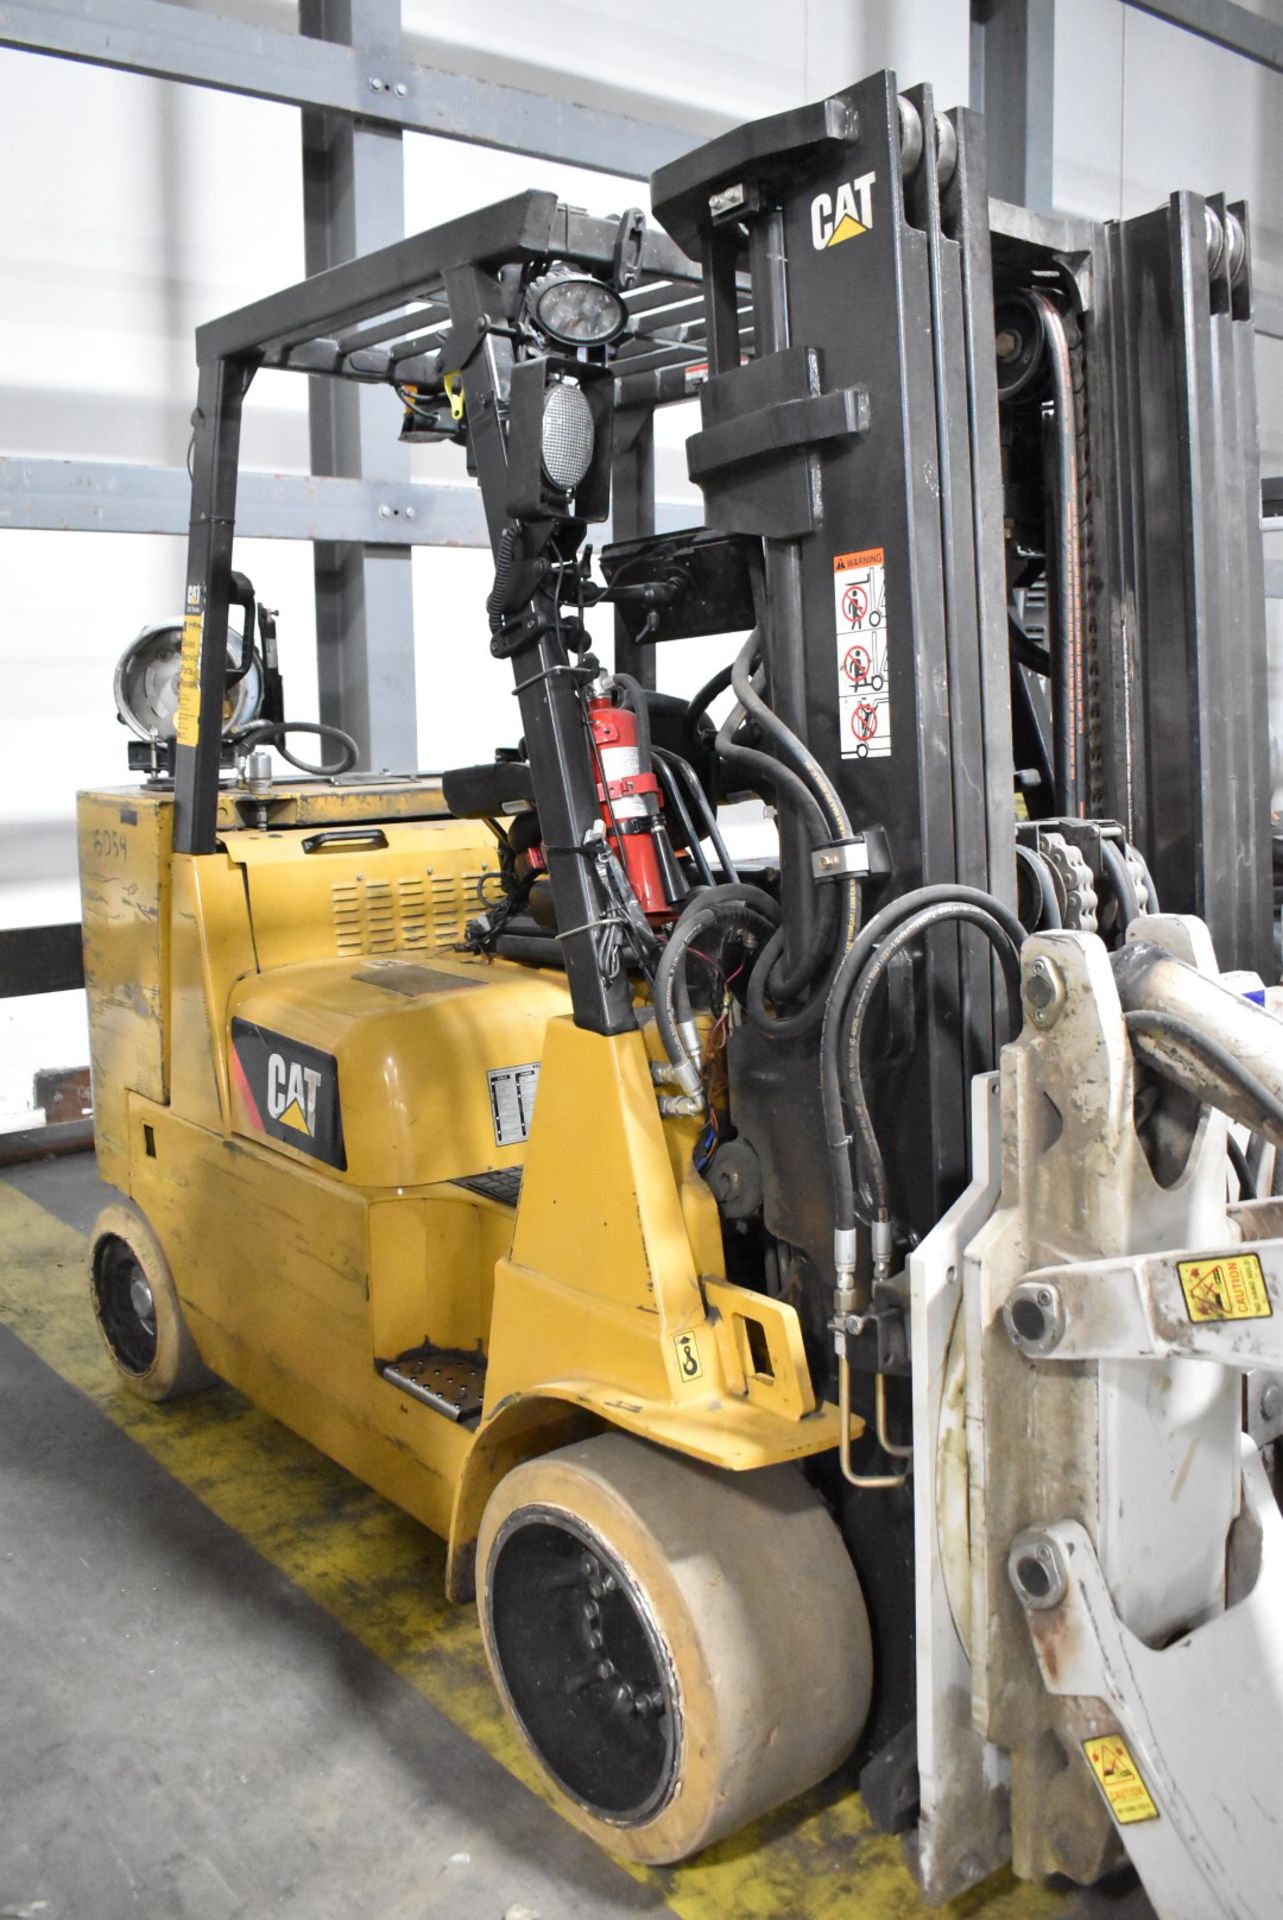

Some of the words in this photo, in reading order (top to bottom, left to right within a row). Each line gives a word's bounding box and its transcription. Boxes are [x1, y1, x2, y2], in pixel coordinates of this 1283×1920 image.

[811, 170, 876, 250] CAT
[847, 553, 882, 566] WARNING
[267, 1053, 322, 1138] CAT
[1227, 1262, 1248, 1313] CAUTION
